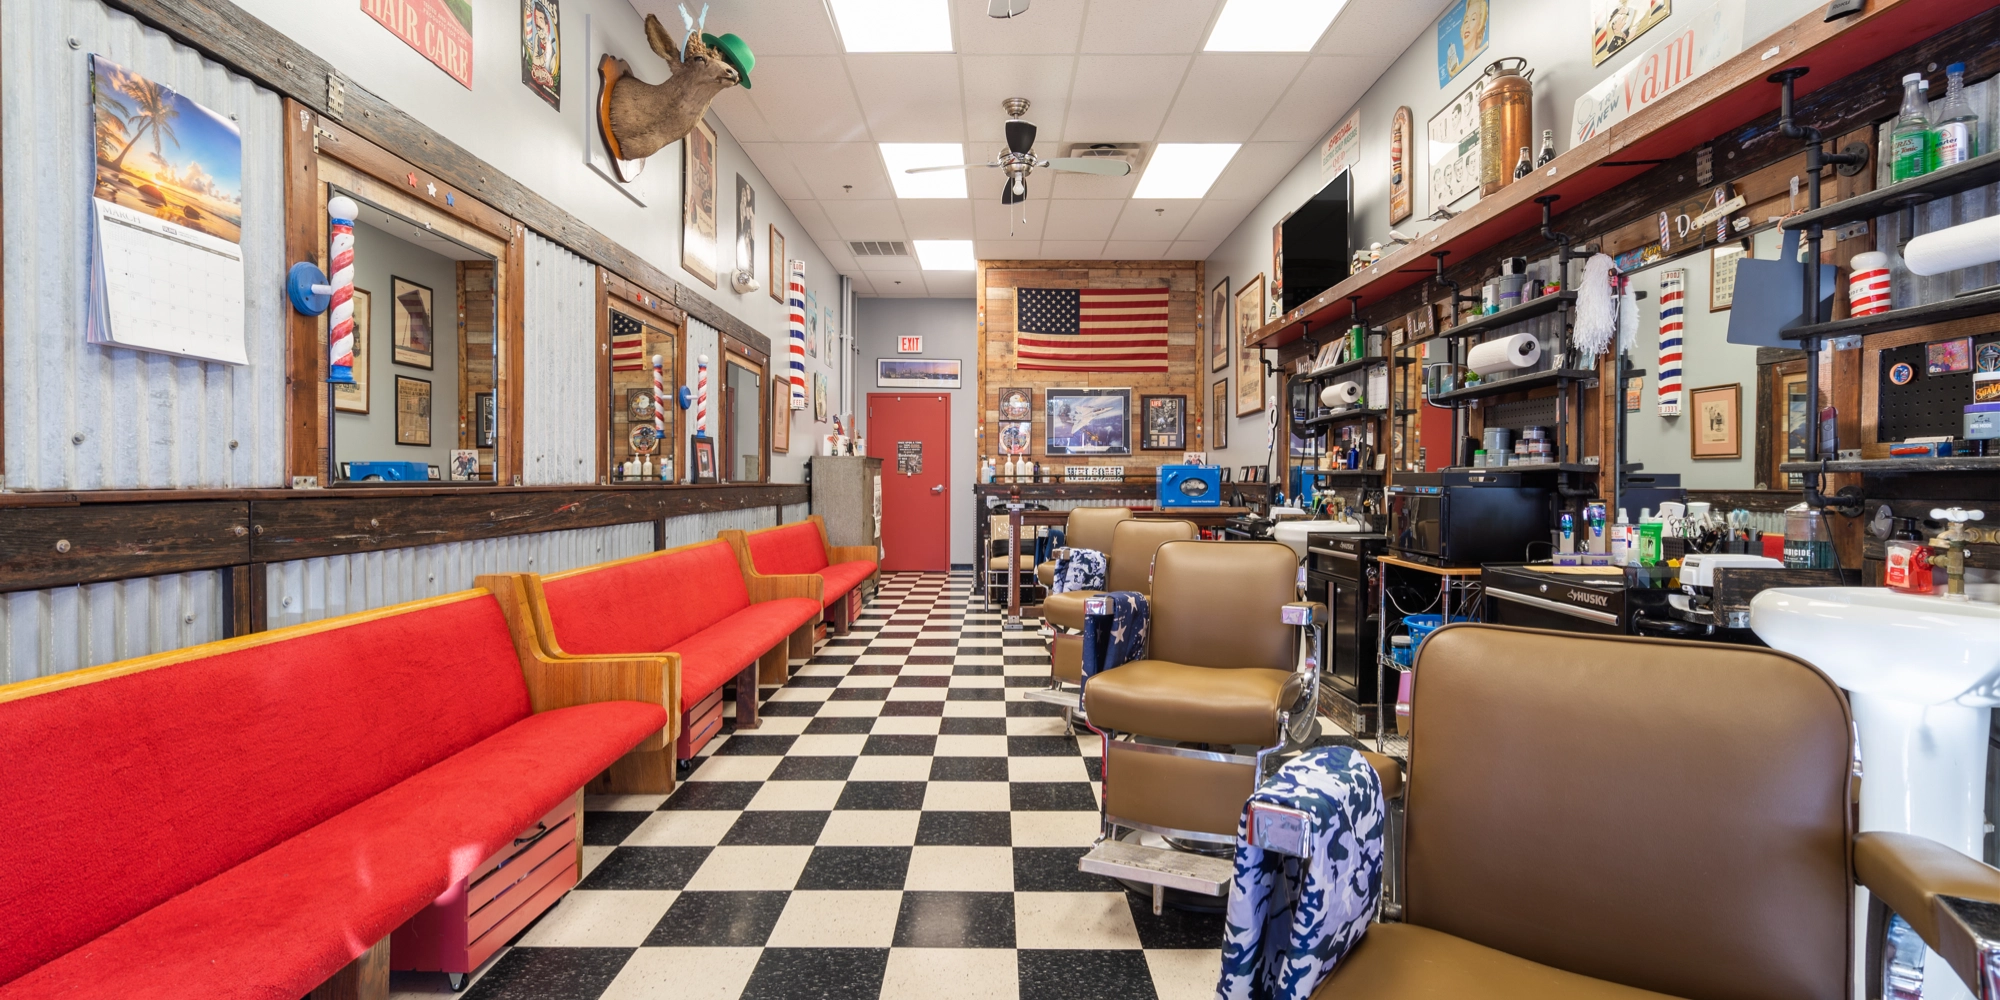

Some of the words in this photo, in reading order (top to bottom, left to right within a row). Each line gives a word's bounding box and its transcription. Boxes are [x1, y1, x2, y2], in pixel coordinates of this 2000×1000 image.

[425, 21, 469, 83] CARE
[1623, 29, 1695, 114] Vam
[1598, 84, 1618, 111] TRY
[1596, 95, 1620, 128] NEW
[1328, 120, 1353, 151] SPECIAL
[1334, 141, 1344, 155] SCALP
[1343, 126, 1358, 147] MASSAGE
[1901, 146, 1919, 154] Tonic
[102, 206, 141, 224] MARCH
[1674, 214, 1698, 238] De
[901, 337, 920, 352] EXIT
[1066, 467, 1122, 481] WELCOME
[1577, 591, 1609, 607] HUSKY
